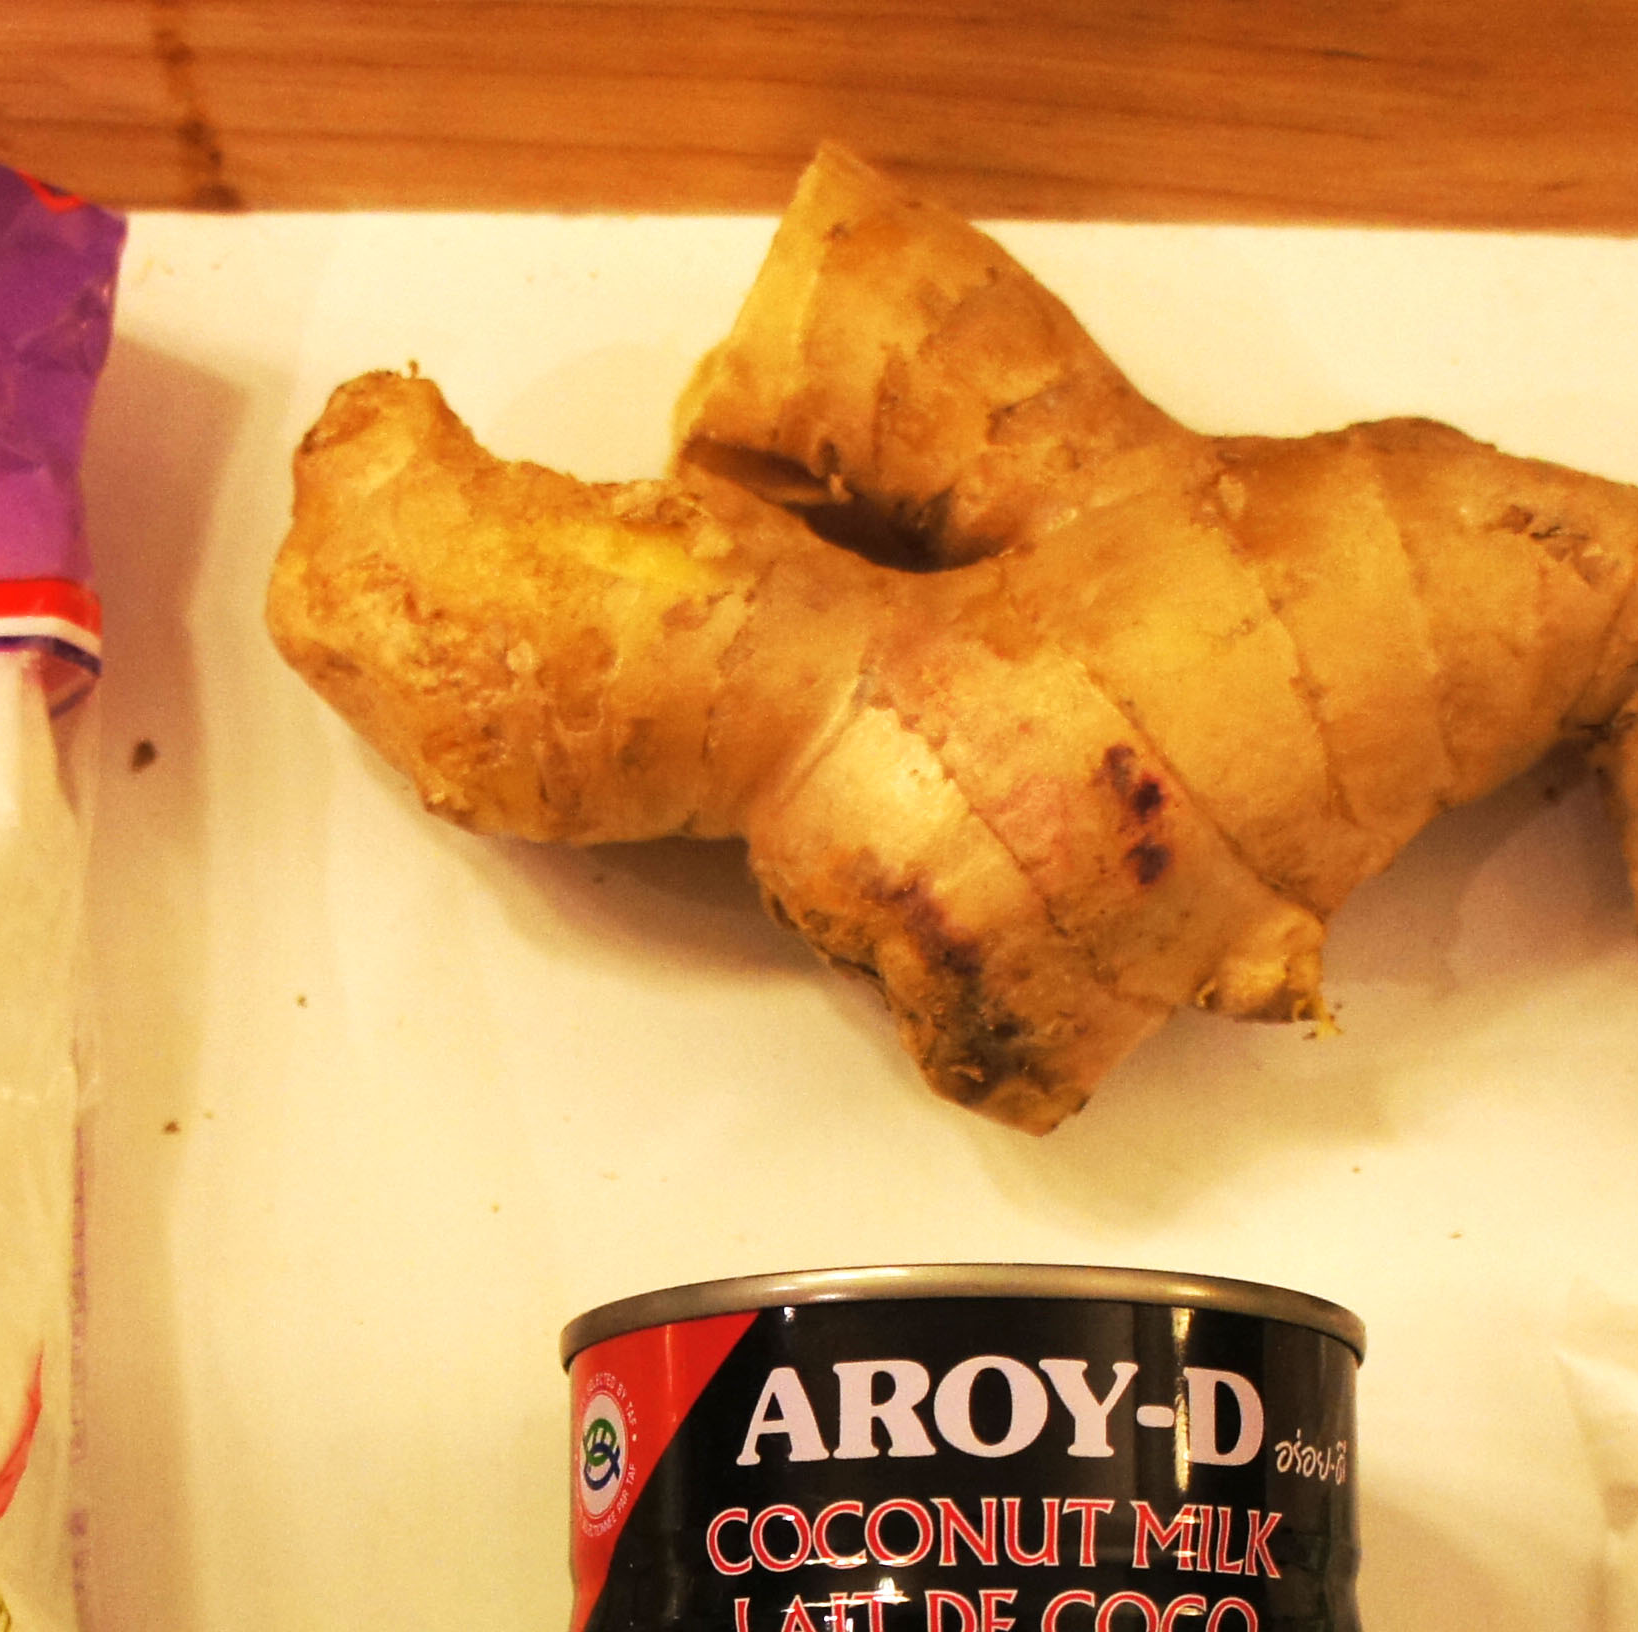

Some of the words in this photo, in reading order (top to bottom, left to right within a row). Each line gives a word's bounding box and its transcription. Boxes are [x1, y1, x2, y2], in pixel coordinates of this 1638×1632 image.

[737, 1355, 1265, 1467] AROY-D
[706, 1497, 1113, 1576] COCONUT
[1130, 1500, 1284, 1580] MILK
